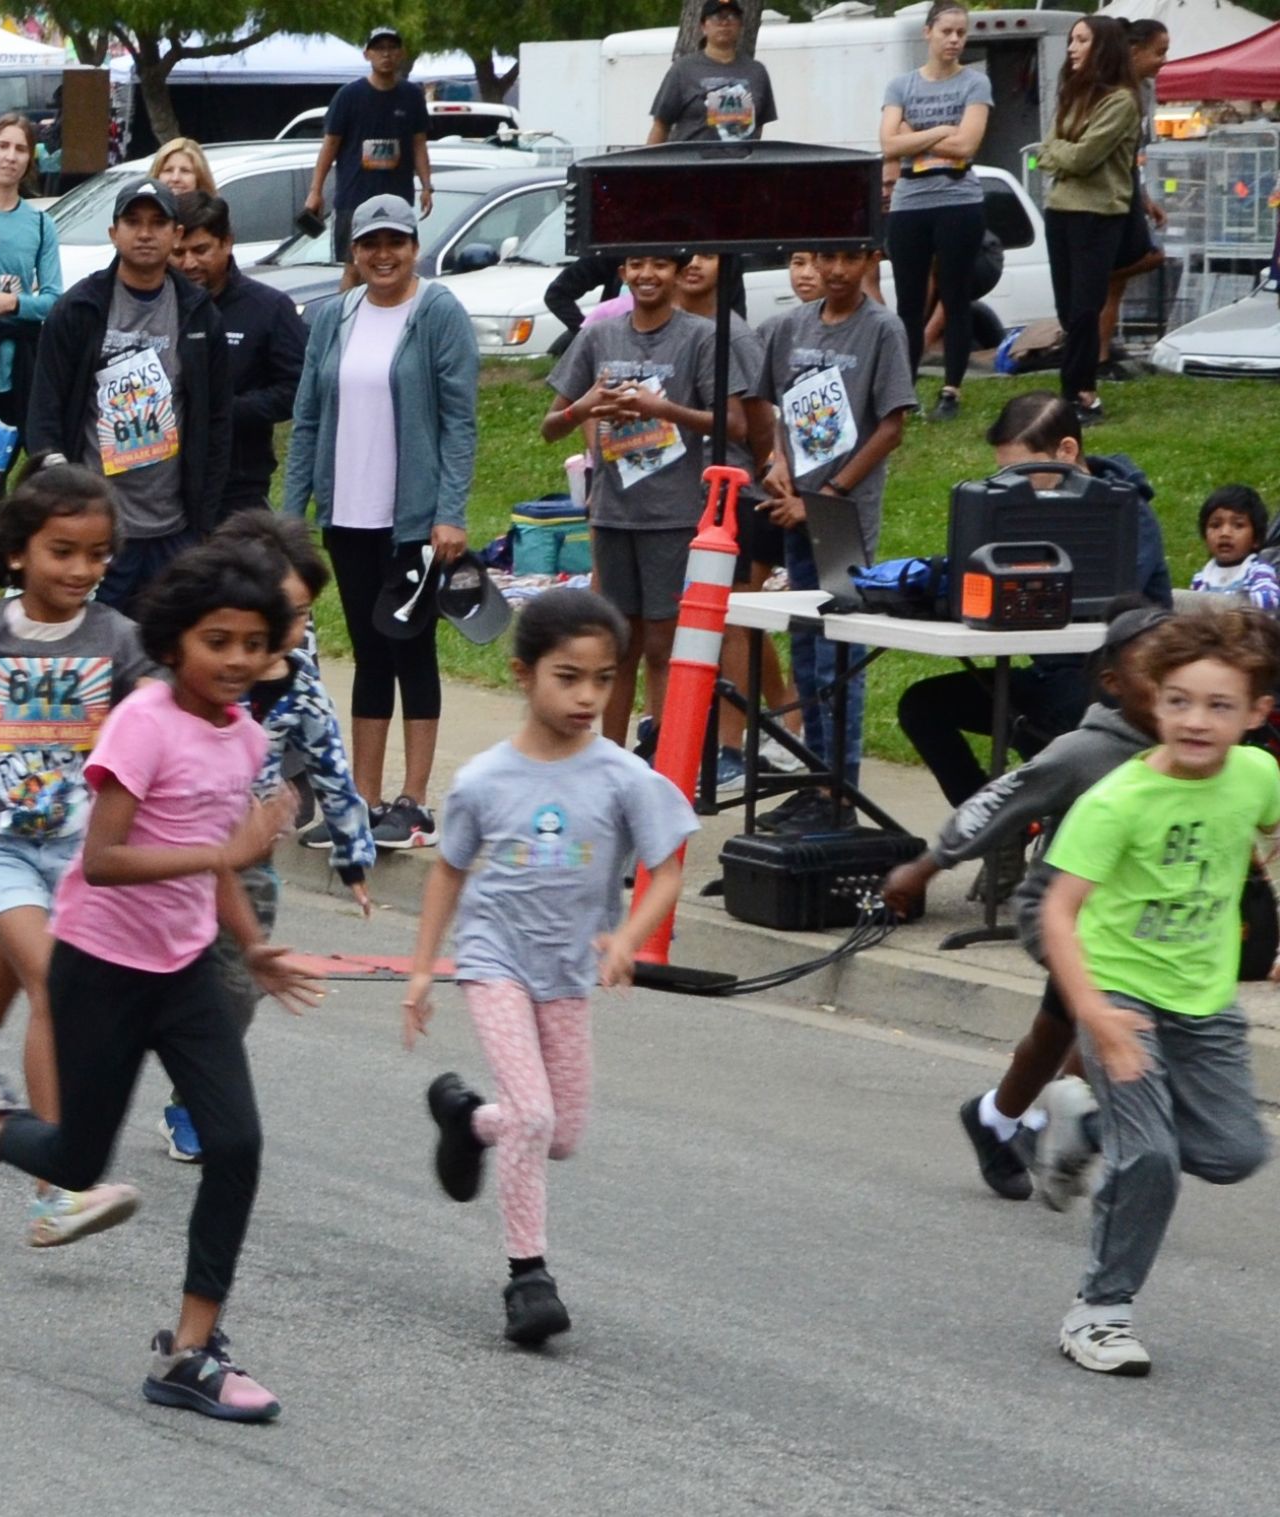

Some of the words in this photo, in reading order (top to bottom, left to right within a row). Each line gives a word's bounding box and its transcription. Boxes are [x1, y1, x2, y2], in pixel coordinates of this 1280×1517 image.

[107, 363, 161, 398] ROCKS
[791, 381, 842, 420] ROCKS
[114, 412, 160, 442] 614
[9, 668, 82, 706] 642
